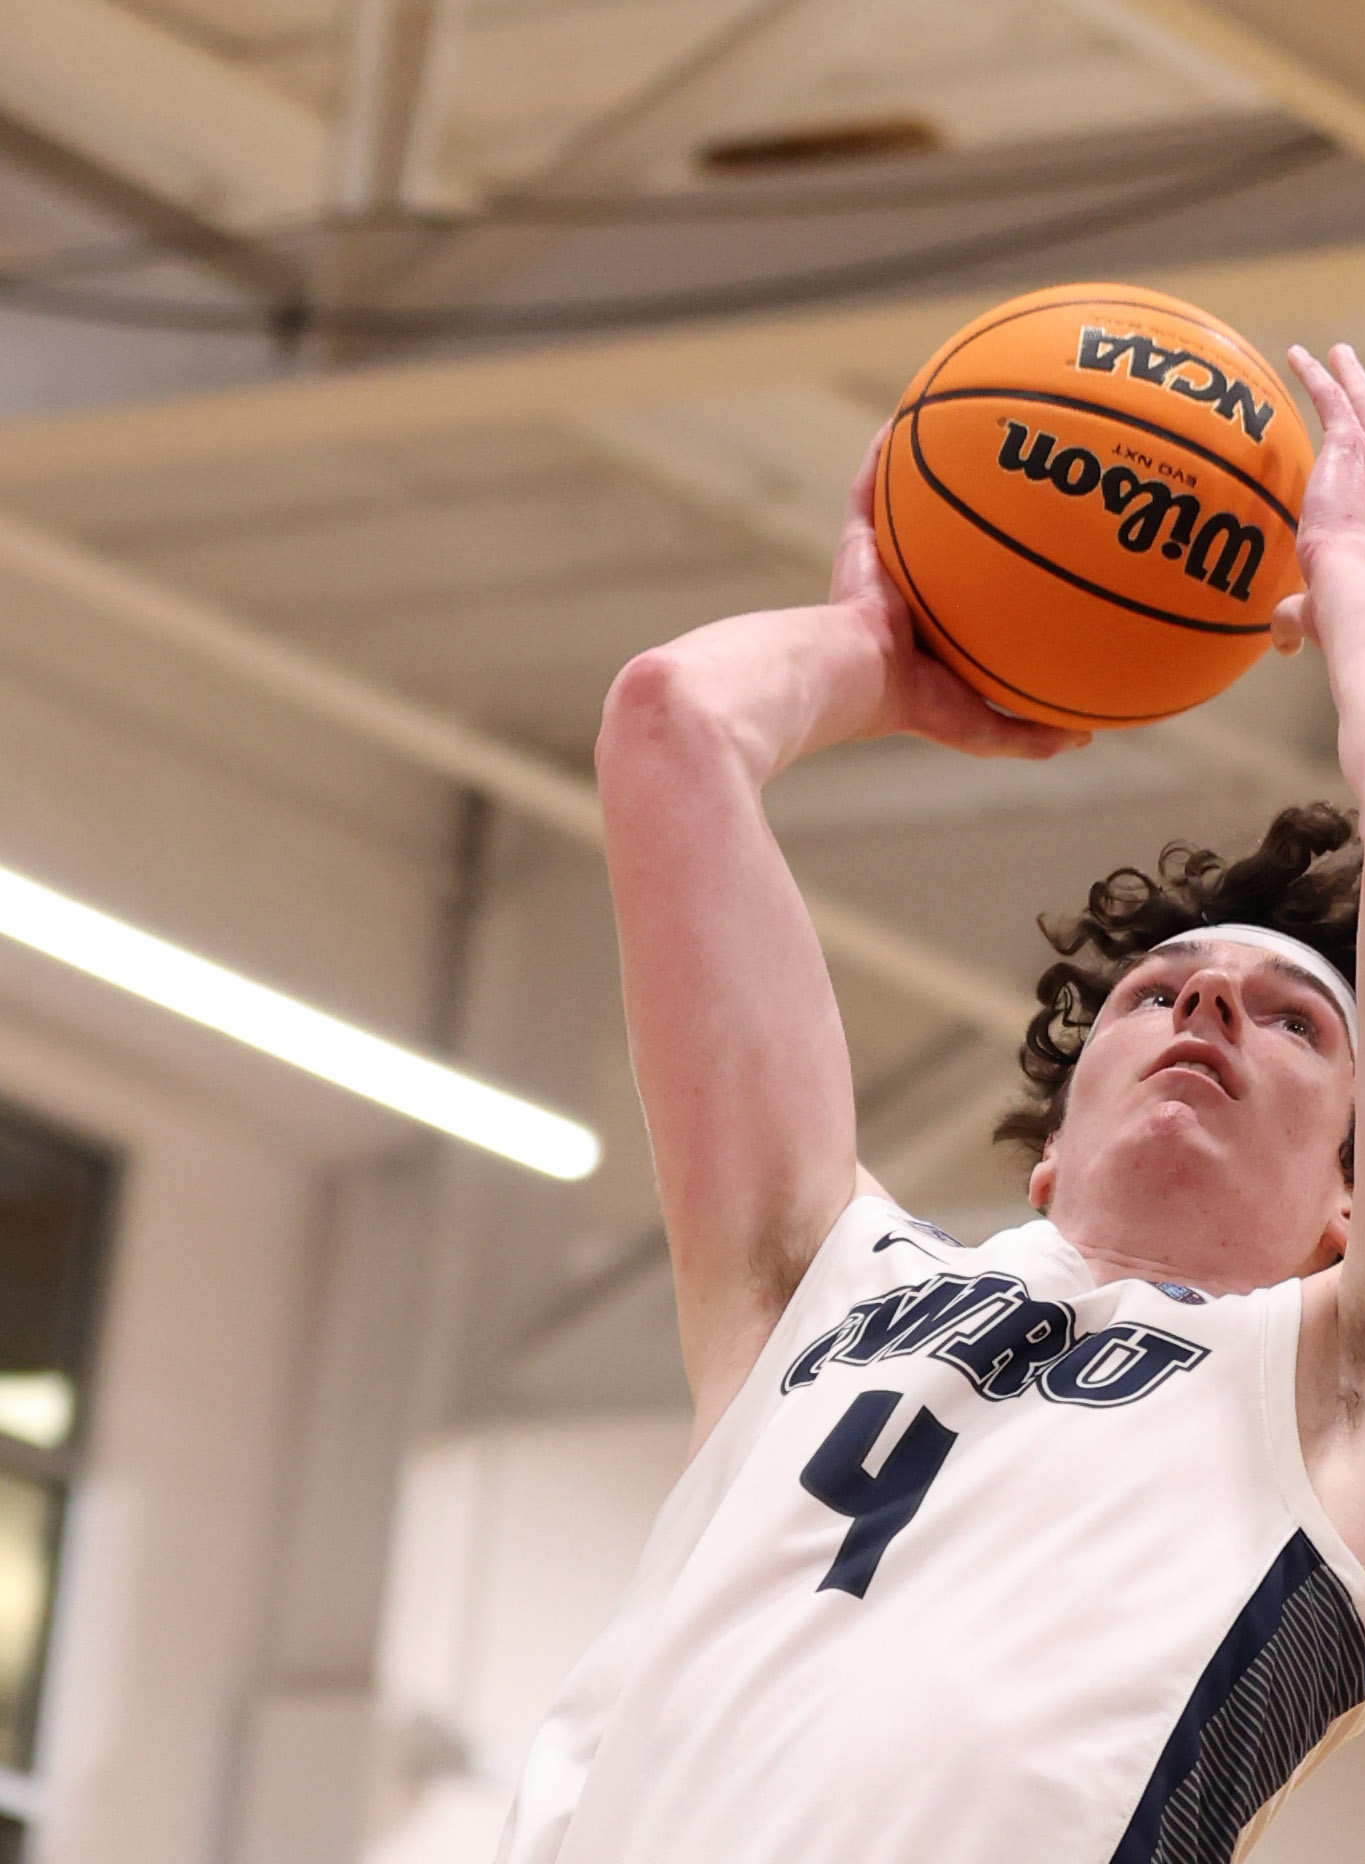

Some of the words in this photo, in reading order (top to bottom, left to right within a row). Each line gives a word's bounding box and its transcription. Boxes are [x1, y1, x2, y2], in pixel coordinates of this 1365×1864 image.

[1077, 325, 1274, 444] NCAA
[998, 420, 1266, 603] Wilson
[1111, 443, 1153, 470] NXT
[1158, 461, 1198, 489] EVO
[799, 1390, 959, 1600] 4
